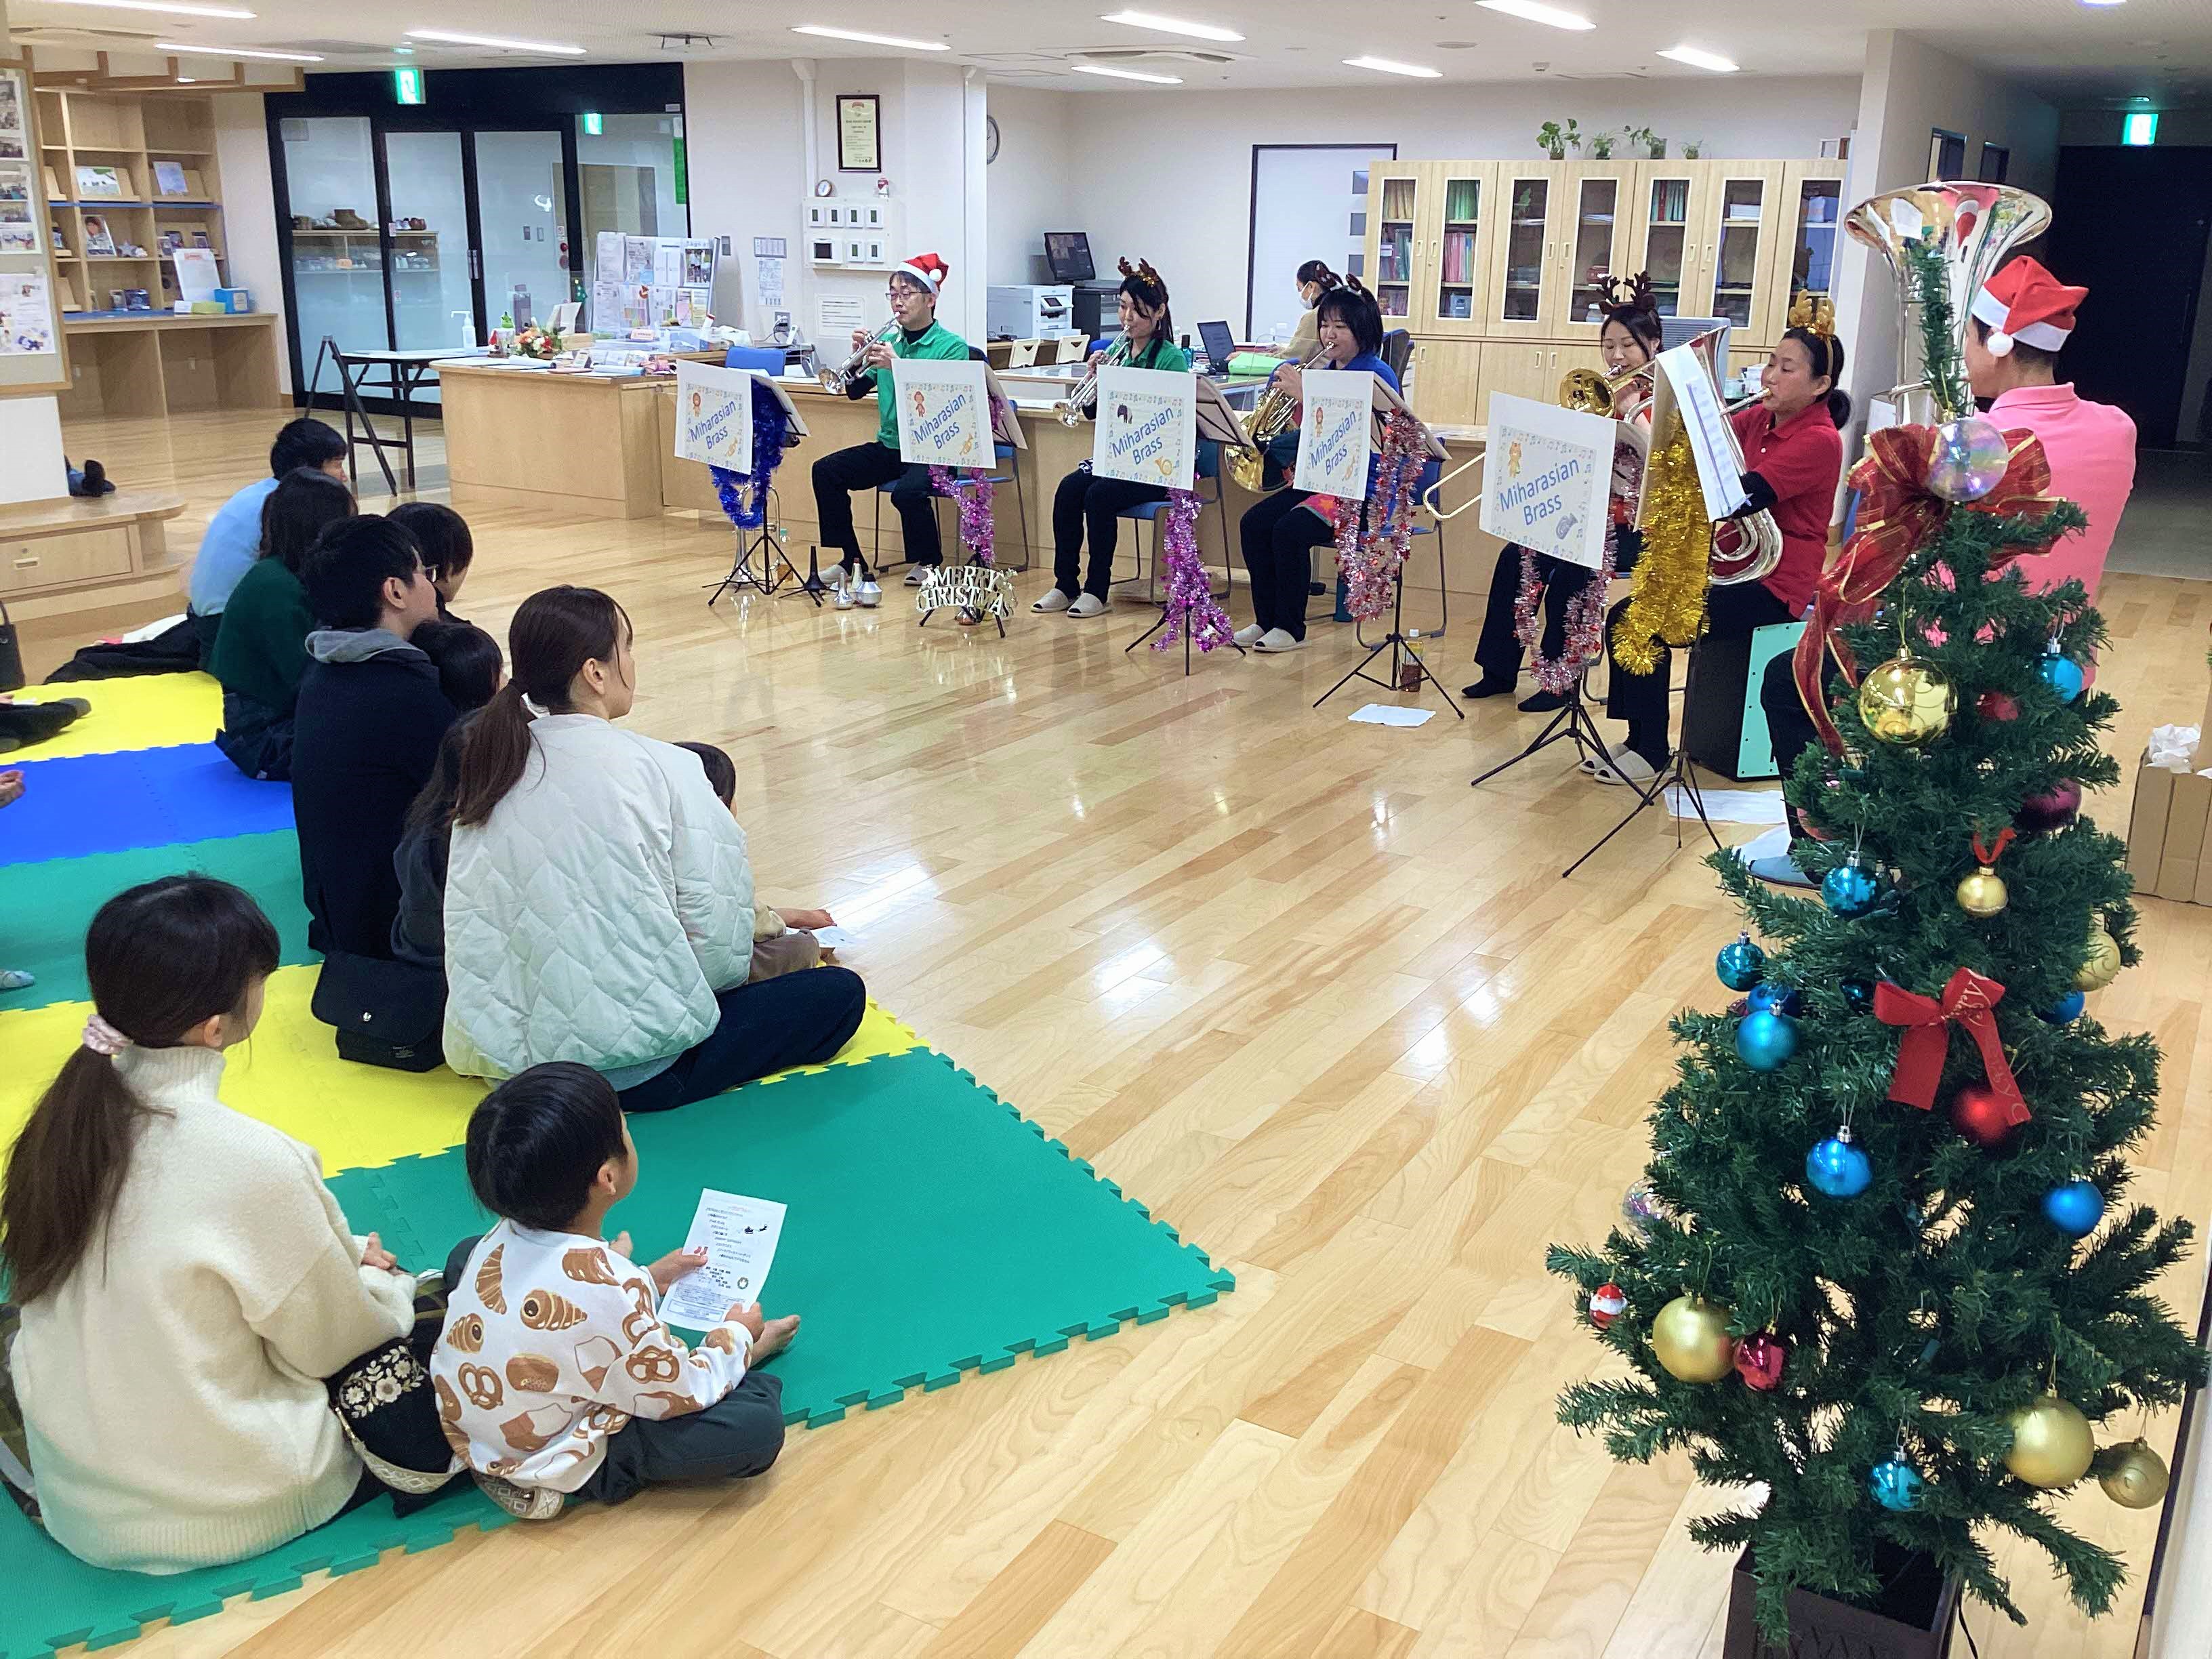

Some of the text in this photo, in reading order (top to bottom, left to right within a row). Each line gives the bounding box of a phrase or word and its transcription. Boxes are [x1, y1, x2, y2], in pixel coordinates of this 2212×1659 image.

[689, 401, 736, 443] Miharasian
[914, 394, 966, 444] Miharasian
[1112, 407, 1174, 458] Miharasian
[706, 426, 728, 449] Brass
[934, 422, 960, 449] Brass
[1133, 437, 1162, 465] Brass
[1311, 411, 1357, 469] Miharasian
[1326, 444, 1347, 476] Brass
[1500, 459, 1579, 512] Miharasian
[1523, 495, 1561, 525] Brass
[933, 565, 1000, 592] MERRY
